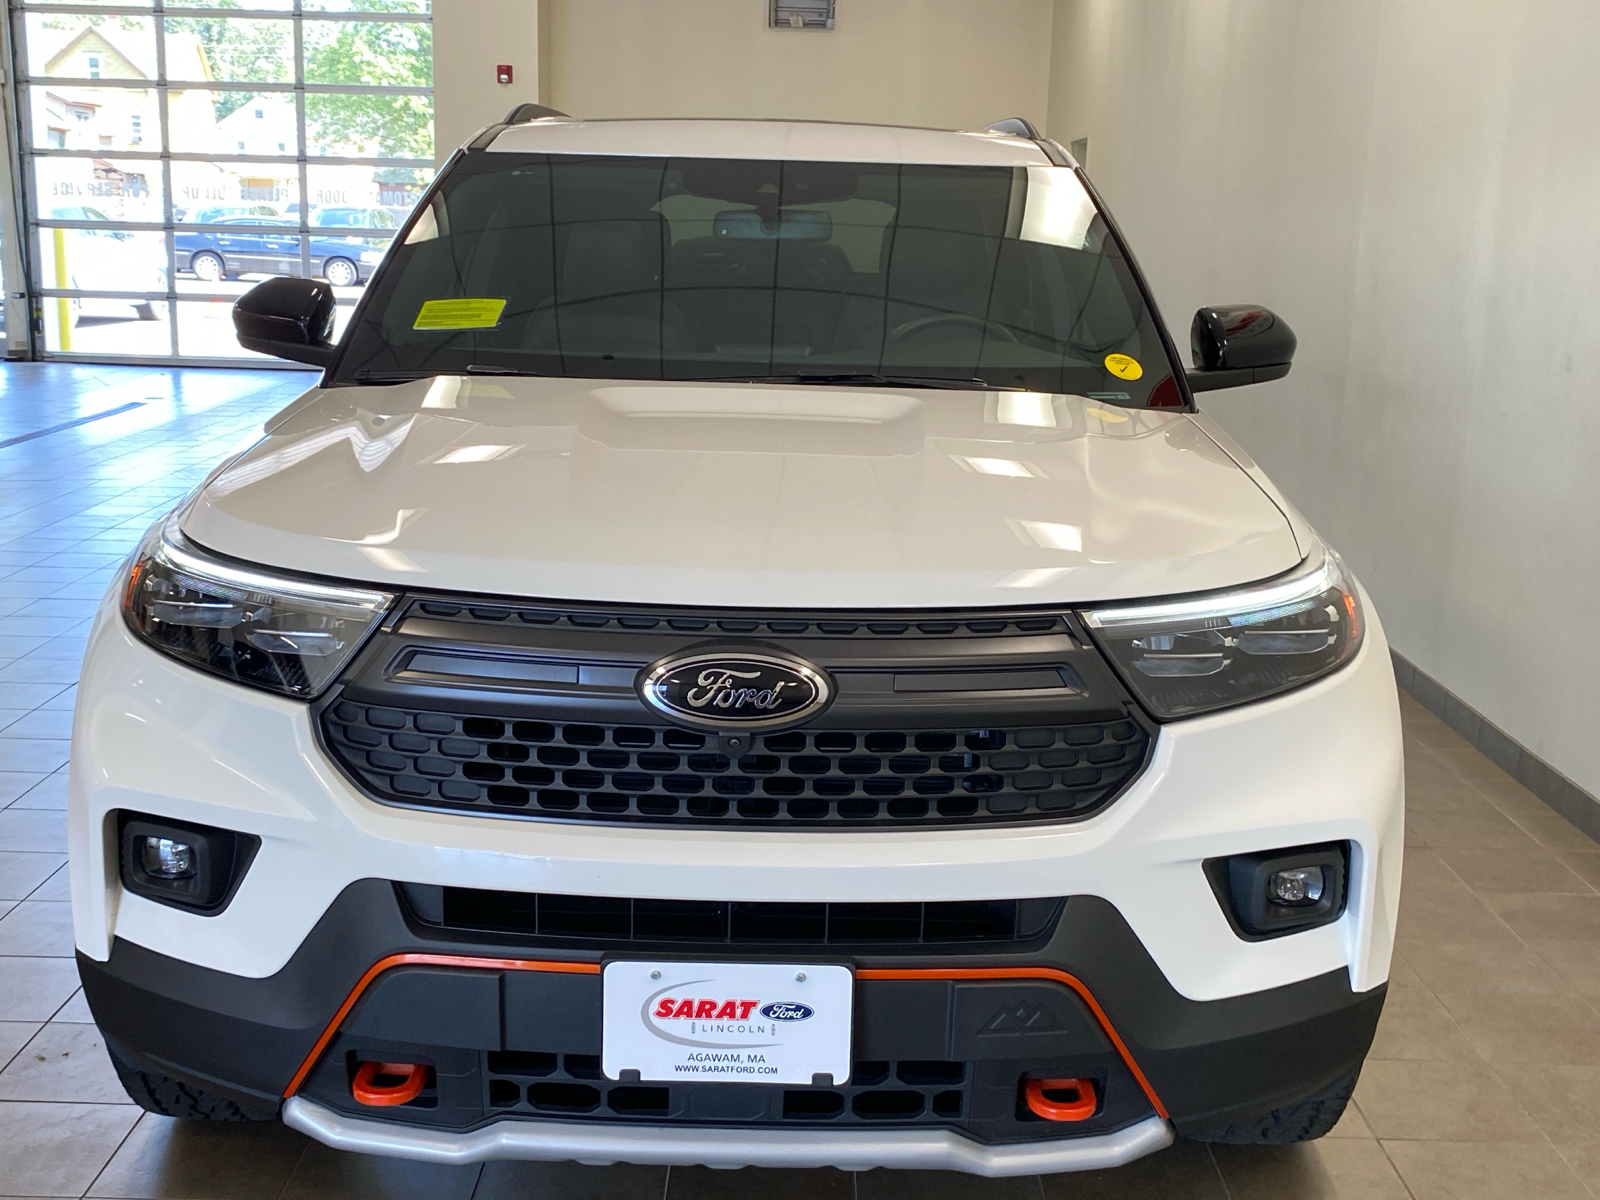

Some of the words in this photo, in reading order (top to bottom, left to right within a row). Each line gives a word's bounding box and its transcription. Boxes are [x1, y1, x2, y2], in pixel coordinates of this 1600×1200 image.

[687, 668, 785, 709] Ford
[653, 997, 760, 1021] SARAT
[768, 1004, 804, 1019] Ford
[702, 1024, 765, 1034] LINCOLN
[687, 1053, 744, 1063] AGAWAM,
[747, 1054, 766, 1063] MA
[674, 1064, 778, 1075] WWW.SARATFORD.COM
